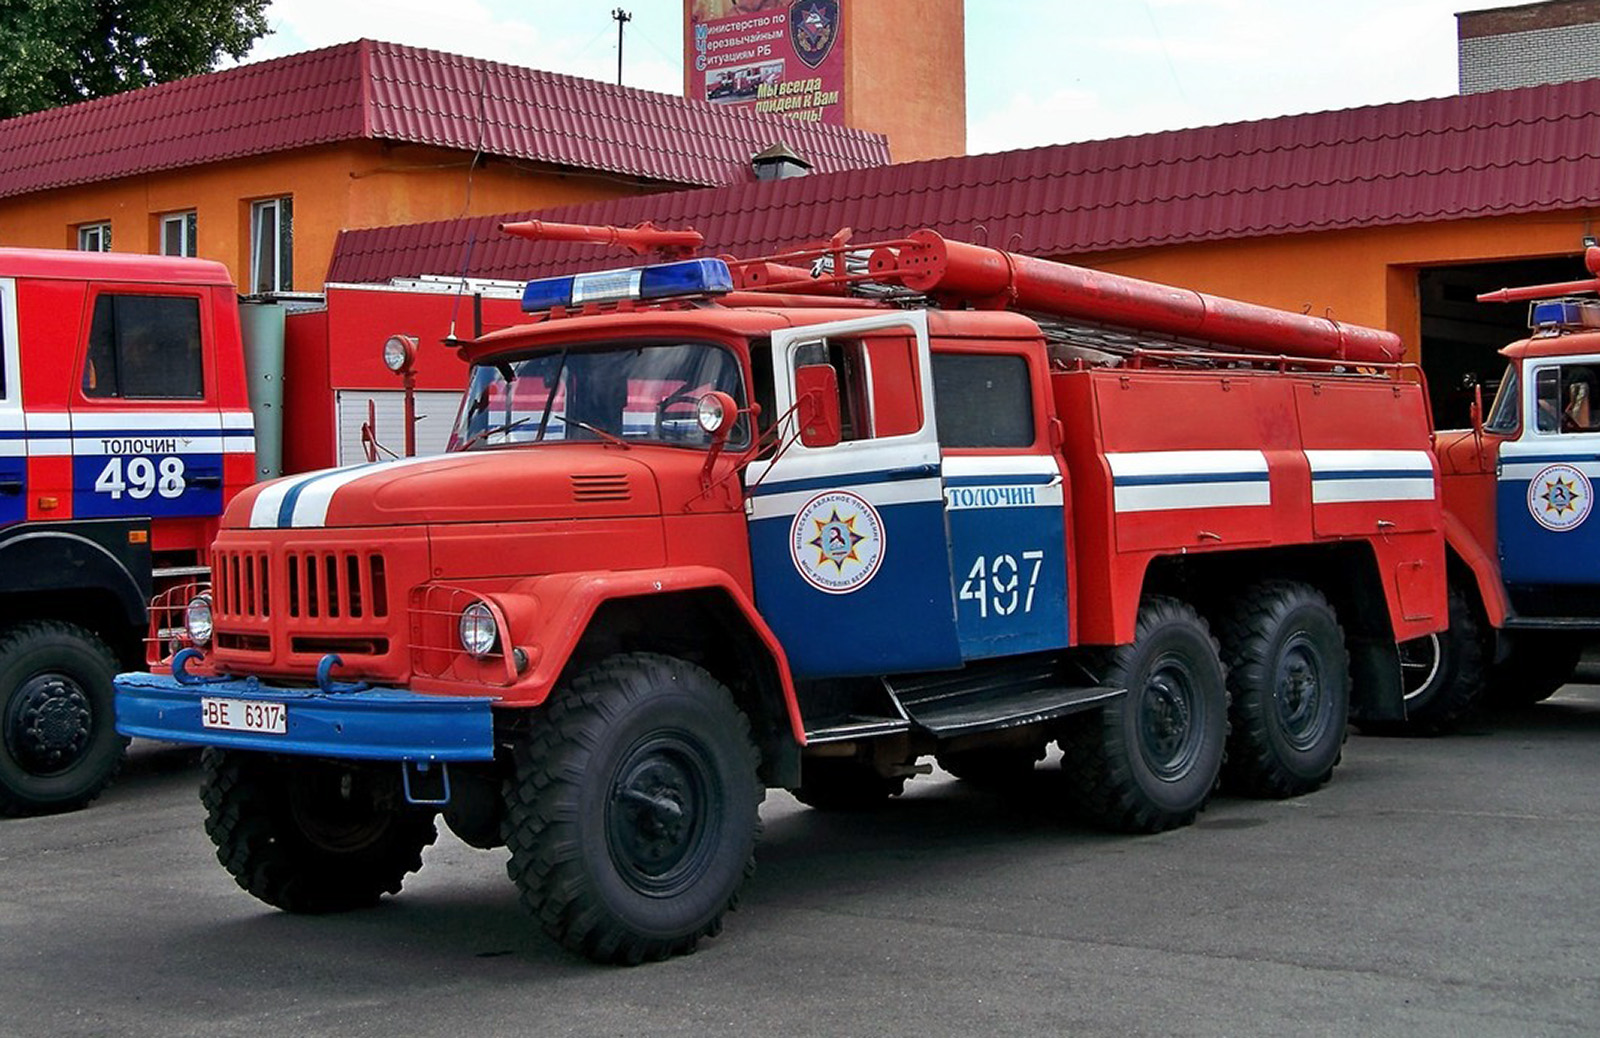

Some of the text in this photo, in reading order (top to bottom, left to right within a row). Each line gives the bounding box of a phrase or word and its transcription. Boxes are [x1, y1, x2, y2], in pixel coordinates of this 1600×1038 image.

[695, 14, 786, 40] Министерство по
[695, 44, 772, 71] Ситуациям РБ
[757, 77, 821, 99] Мы всегда
[803, 94, 812, 108] к
[813, 91, 839, 106] Вам
[101, 439, 176, 454] ТОЛОЧИН
[95, 457, 186, 499] 498
[950, 487, 1036, 506] ТОЛОЧИН
[959, 550, 1044, 617] 497
[245, 704, 280, 729] 6317
